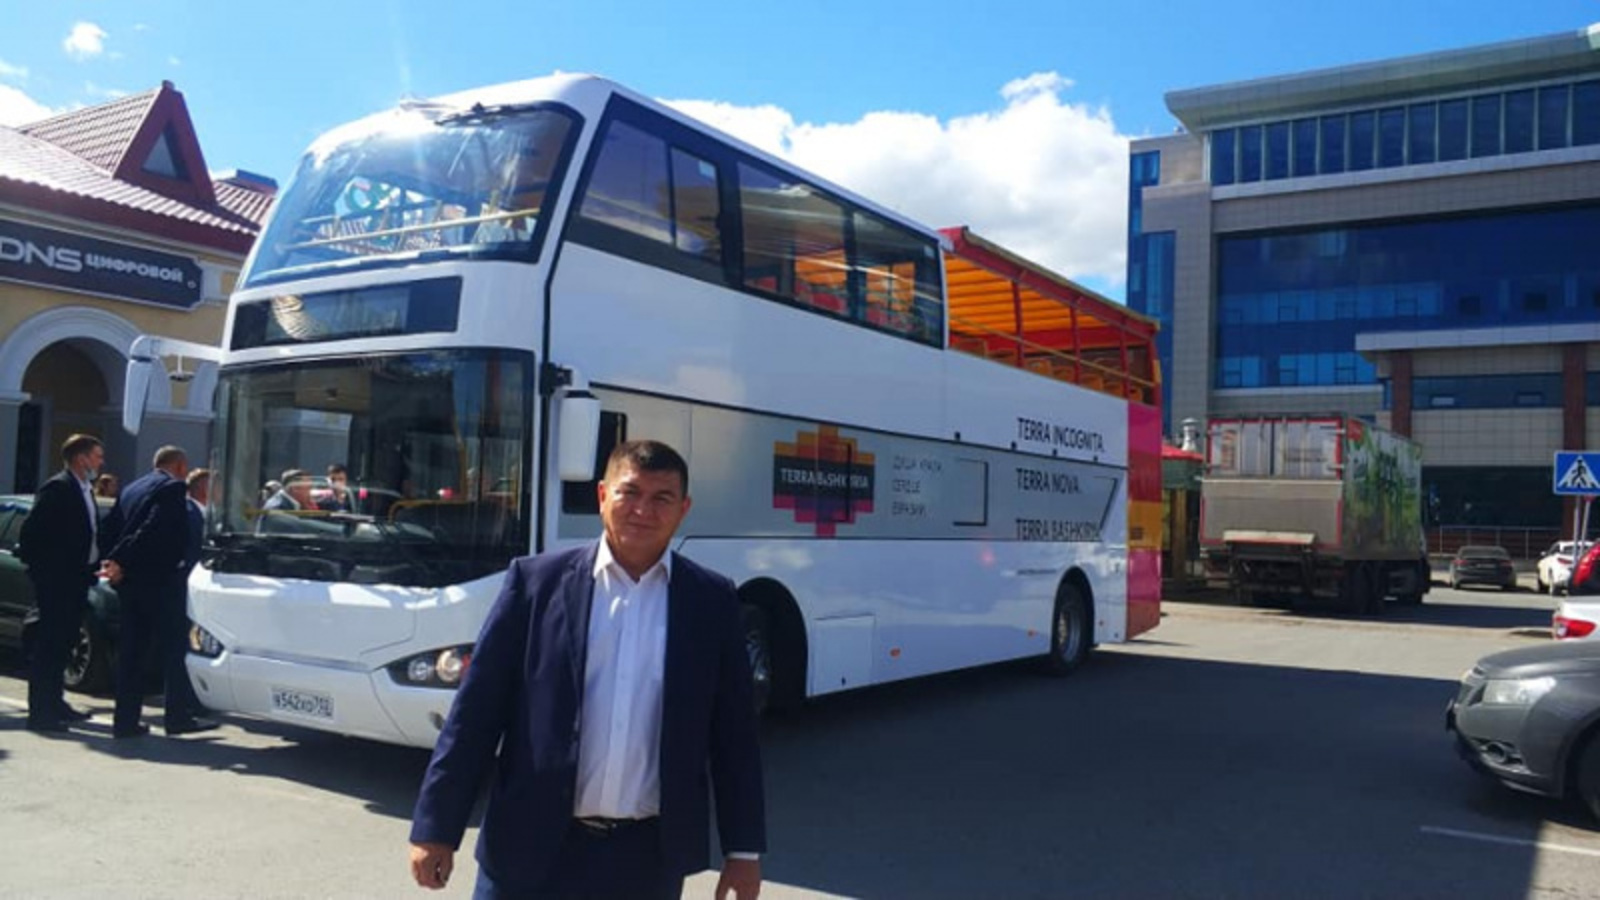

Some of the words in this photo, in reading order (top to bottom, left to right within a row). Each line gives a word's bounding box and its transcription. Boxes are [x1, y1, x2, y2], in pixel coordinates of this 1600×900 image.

[0, 236, 83, 273] DNS
[85, 253, 184, 282] ЦИФРОВОЙ
[1017, 417, 1050, 443] TERRA
[780, 467, 815, 485] TERRA
[1016, 467, 1050, 493] TERRA
[1015, 518, 1049, 541] TERRA
